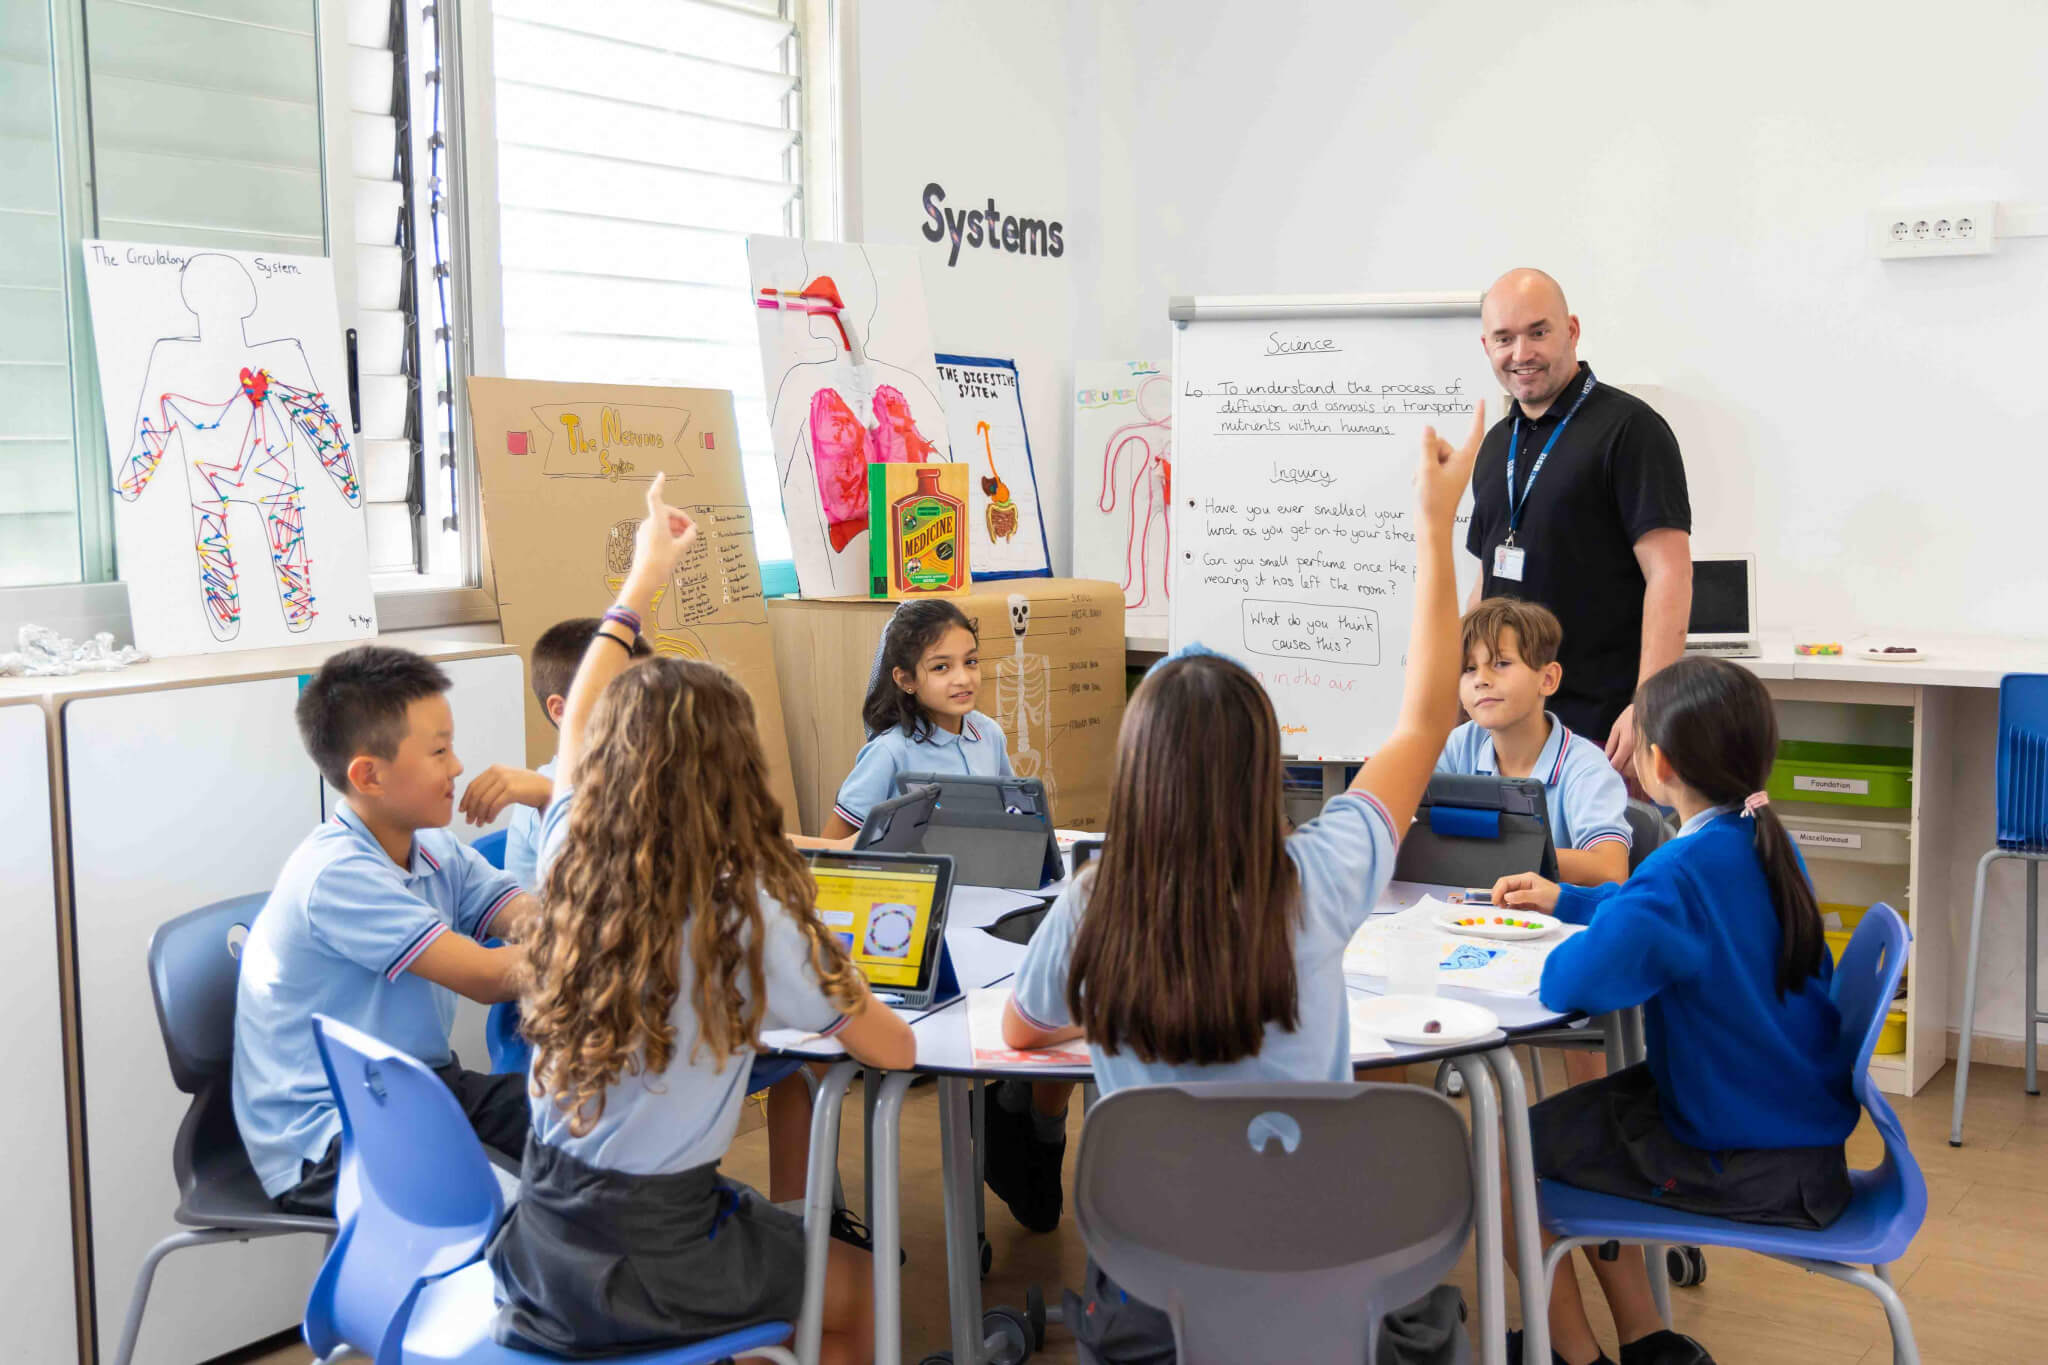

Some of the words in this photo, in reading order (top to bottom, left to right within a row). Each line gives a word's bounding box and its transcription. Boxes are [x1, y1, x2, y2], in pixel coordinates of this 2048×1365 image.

[922, 182, 1065, 268] Systems
[91, 246, 119, 266] The
[126, 248, 185, 272] Circulatory
[254, 258, 302, 278] System
[1266, 331, 1336, 355] Science
[936, 366, 959, 383] THE
[963, 371, 1016, 387] DIGESTIVE
[1217, 381, 1239, 395] To
[1246, 378, 1337, 394] understand
[1347, 380, 1373, 394] the
[1381, 383, 1436, 400] process
[1445, 377, 1463, 394] of
[958, 384, 999, 399] SYSTEM
[1221, 398, 1288, 413] diffusion
[1292, 400, 1319, 412] and
[1324, 402, 1376, 414] osmosis
[1383, 402, 1396, 414] in
[559, 413, 598, 455] The
[1287, 418, 1332, 432] within
[1339, 418, 1391, 435] humans
[1271, 461, 1331, 487] Inquiry
[1204, 496, 1239, 514] Have
[1246, 505, 1270, 522] you
[1277, 504, 1305, 514] ever
[1314, 501, 1367, 518] smelled
[1375, 509, 1405, 529] your
[904, 515, 954, 558] MEDICINE
[1206, 519, 1237, 536] lunch
[1242, 526, 1257, 536] as
[1261, 524, 1284, 541] you
[1290, 519, 1312, 542] get
[1350, 528, 1380, 544] your
[1203, 552, 1228, 566] Can
[1233, 557, 1254, 573] you
[1259, 554, 1289, 568] smell
[1296, 550, 1346, 574] perfume
[1353, 561, 1383, 573] once
[1389, 559, 1408, 574] the
[1204, 574, 1249, 593] wearing
[1255, 571, 1266, 587] it
[1273, 575, 1294, 587] has
[1300, 573, 1321, 590] left
[1329, 576, 1349, 592] the
[1250, 609, 1281, 626] What
[1288, 612, 1301, 627] do
[1306, 619, 1329, 636] you
[1338, 614, 1374, 633] think
[1272, 639, 1312, 651] causes
[1810, 779, 1851, 790] Foundation
[1799, 833, 1849, 844] Miscellaneous
